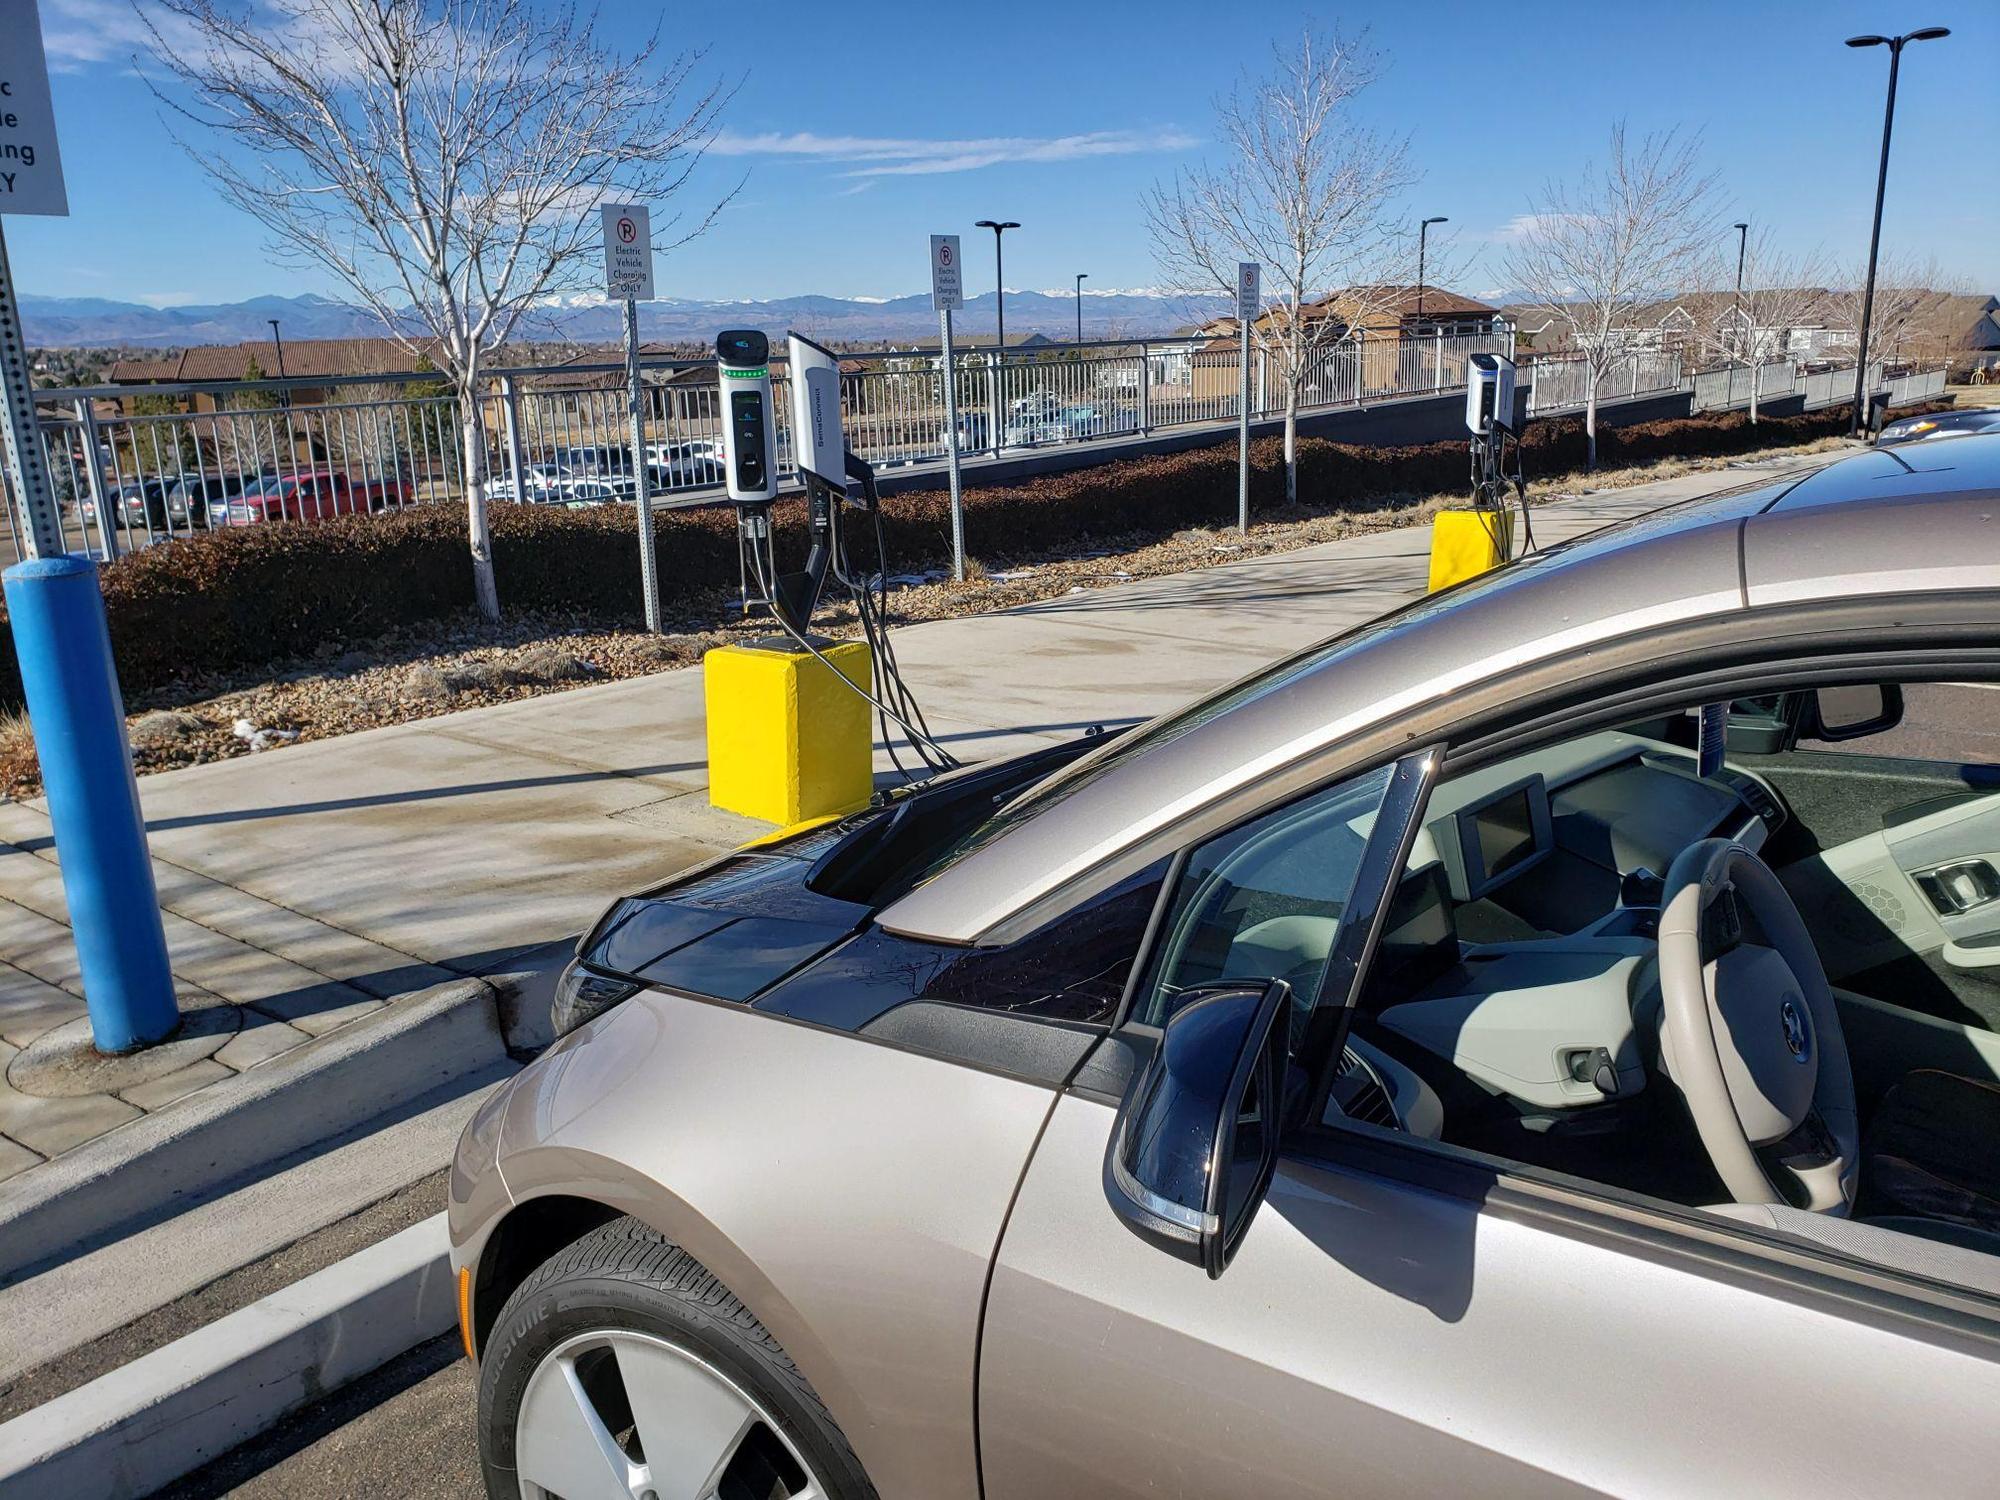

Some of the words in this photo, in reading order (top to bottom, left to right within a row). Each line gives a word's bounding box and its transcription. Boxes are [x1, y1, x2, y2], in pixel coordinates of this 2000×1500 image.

[615, 246, 641, 256] Electric
[616, 258, 643, 268] Vehicle
[613, 270, 647, 282] Charging
[620, 284, 642, 293] ONLY
